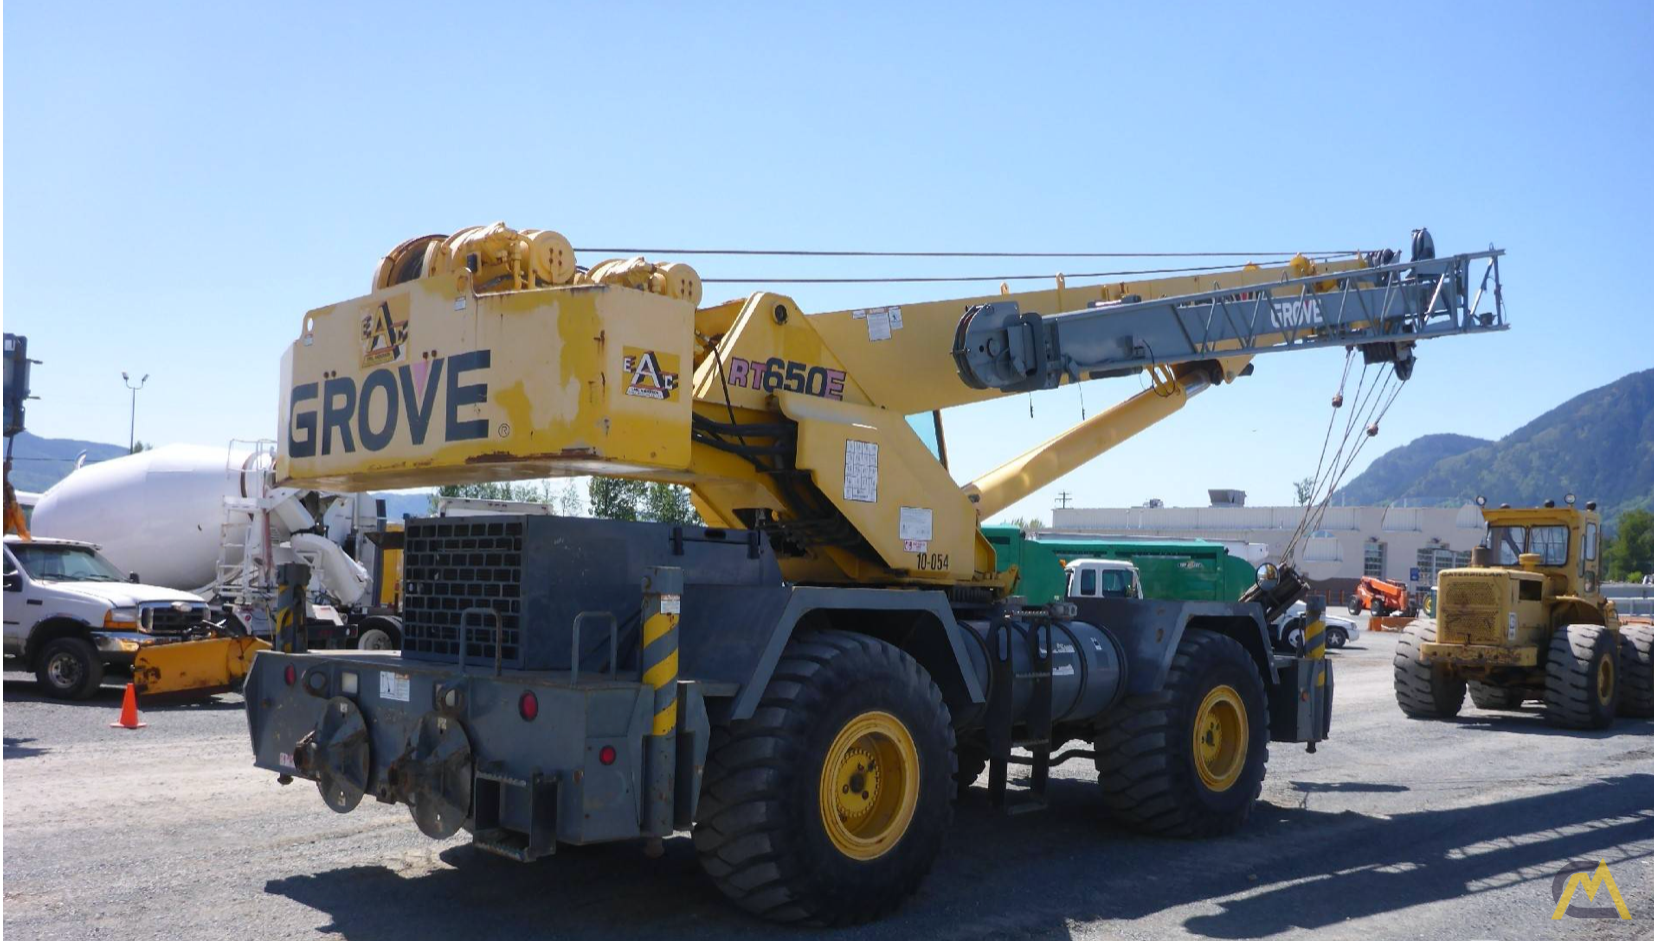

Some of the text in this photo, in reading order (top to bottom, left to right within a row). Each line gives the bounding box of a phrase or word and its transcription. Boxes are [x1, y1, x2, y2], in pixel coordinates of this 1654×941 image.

[1270, 299, 1324, 329] GROVE
[728, 356, 847, 402] RT650E
[288, 349, 492, 458] GROVE
[917, 552, 949, 570] 10-054
